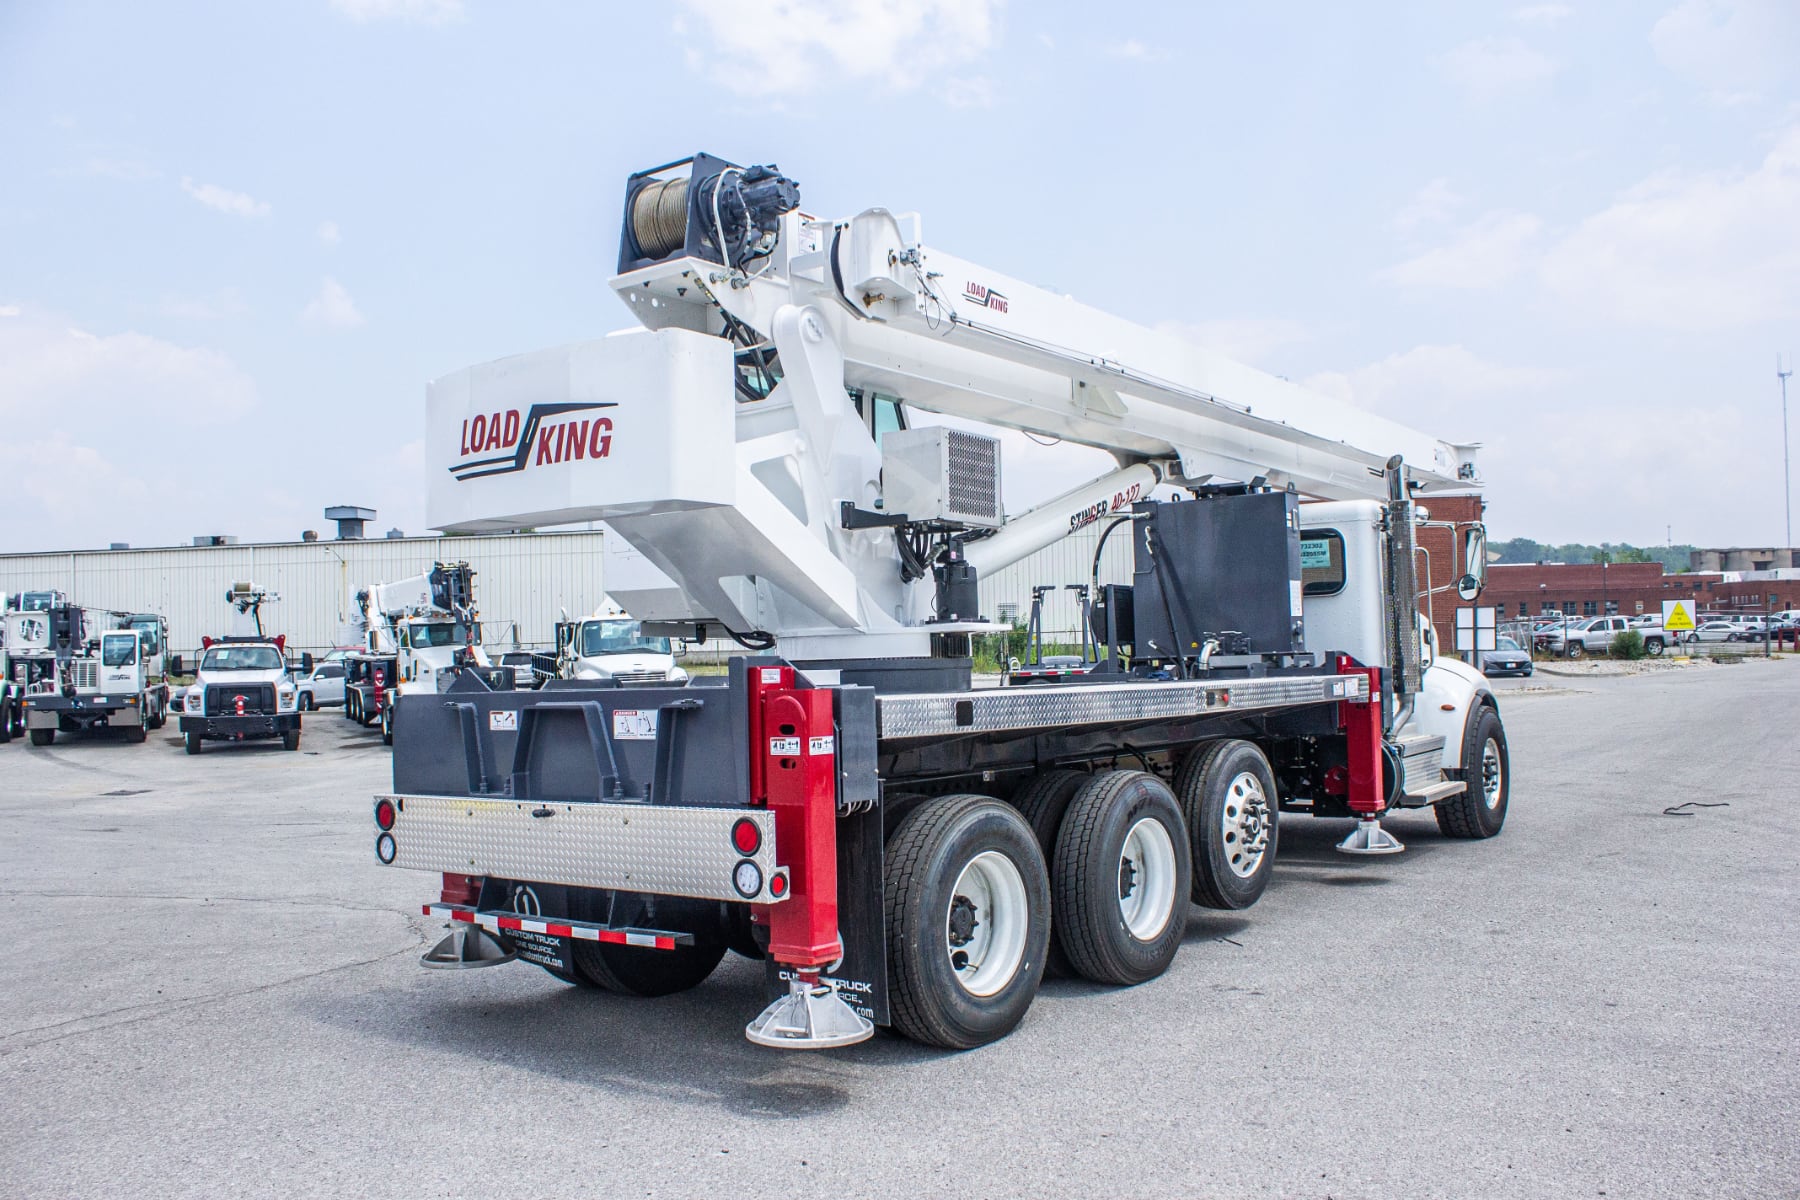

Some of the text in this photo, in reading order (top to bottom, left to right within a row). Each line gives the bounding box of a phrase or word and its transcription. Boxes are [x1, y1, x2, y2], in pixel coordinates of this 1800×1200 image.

[966, 281, 1008, 314] LOAD KING
[461, 409, 613, 466] LOAD KING
[1068, 499, 1108, 535] STINGER
[505, 928, 560, 947] CUSTOM TRUCK
[838, 980, 872, 993] RUCK
